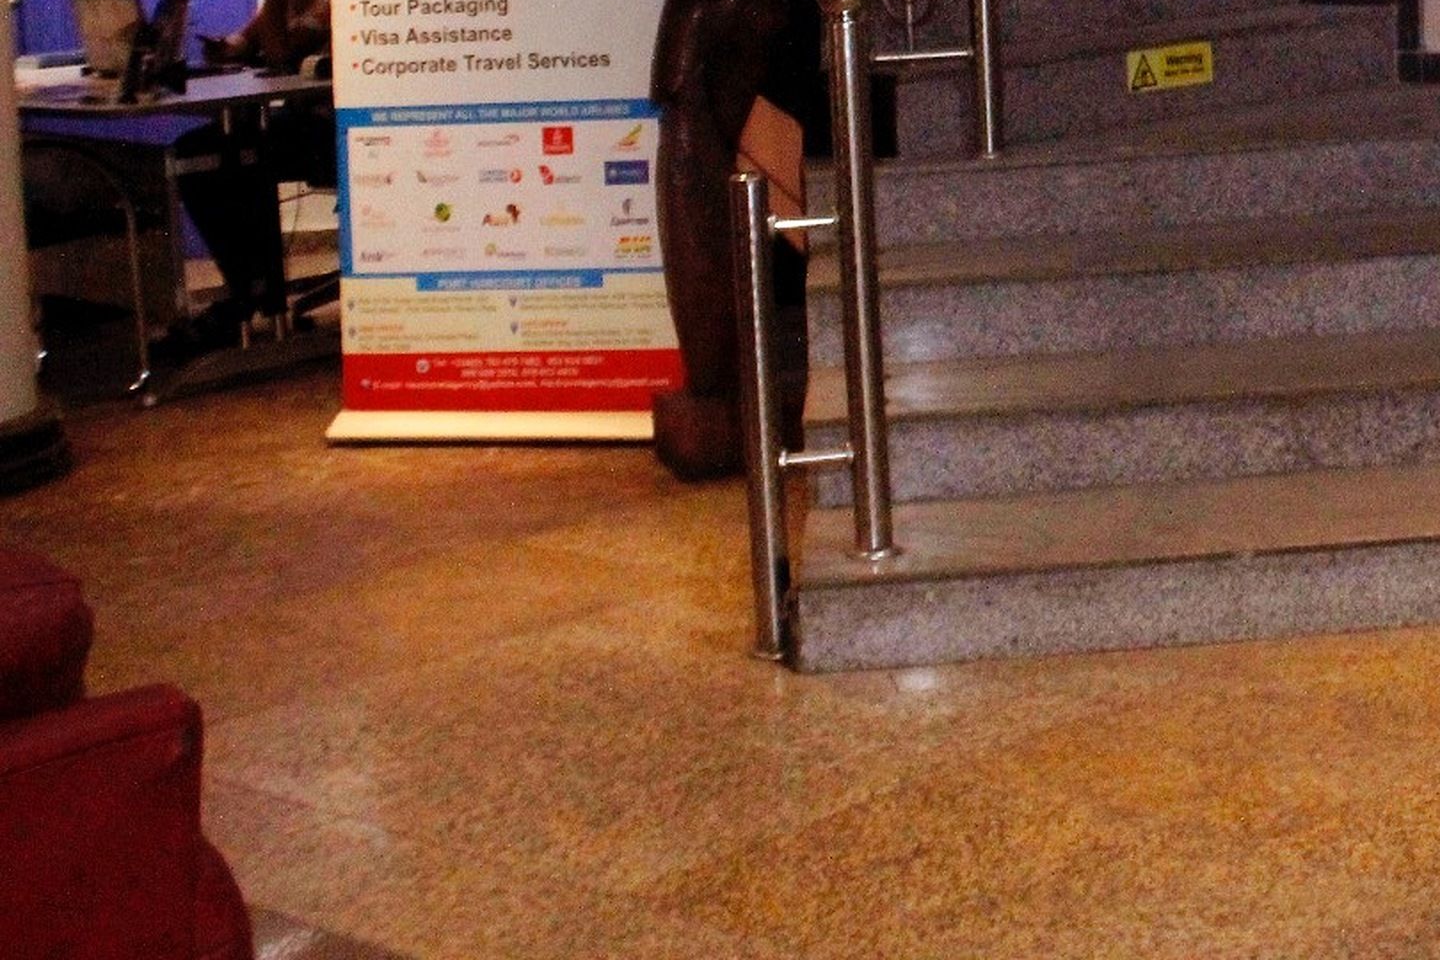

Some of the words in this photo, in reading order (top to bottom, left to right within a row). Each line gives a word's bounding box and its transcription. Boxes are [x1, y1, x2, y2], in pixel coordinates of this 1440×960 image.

[361, 0, 401, 17] Tour
[361, 30, 400, 46] Visa
[406, 27, 513, 45] Assistance
[361, 55, 457, 78] Corporate
[464, 53, 522, 71] Travel
[528, 50, 611, 70] Services
